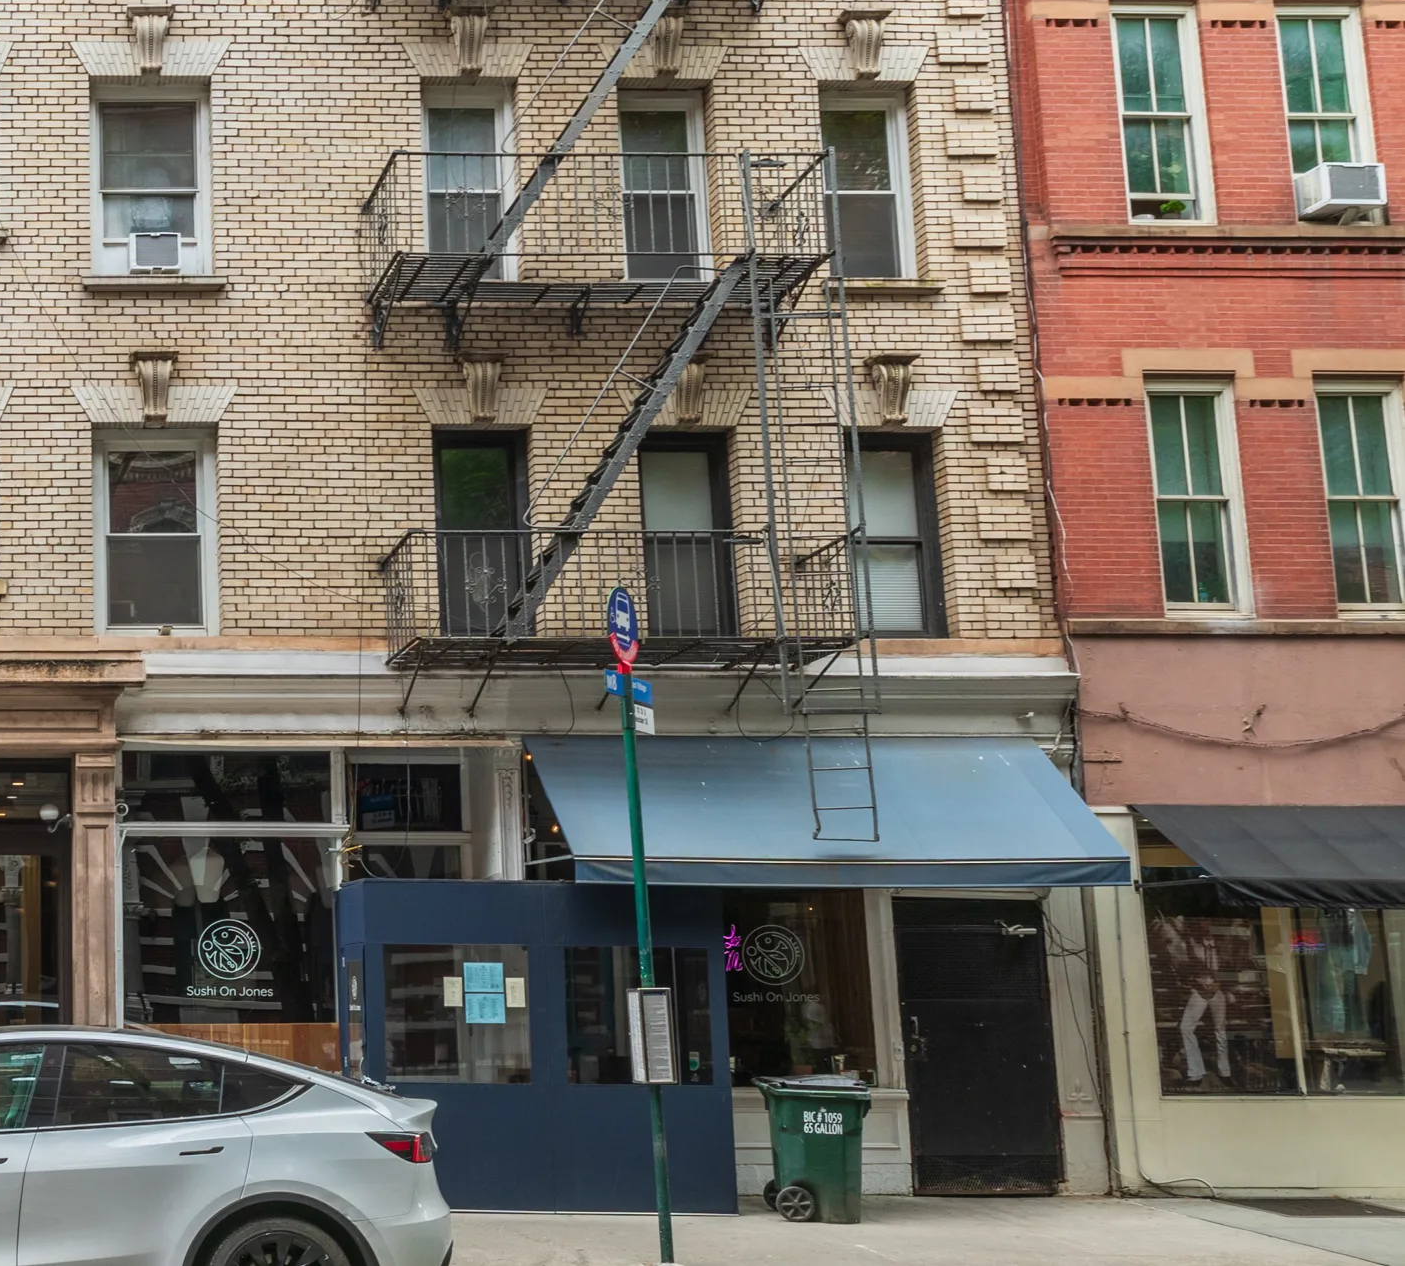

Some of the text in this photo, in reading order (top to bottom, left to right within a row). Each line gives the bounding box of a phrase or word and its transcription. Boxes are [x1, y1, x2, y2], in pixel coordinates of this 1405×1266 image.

[186, 985, 274, 997] Sushi On Jones
[732, 991, 821, 1003] Sushi On Jones
[803, 1110, 816, 1123] BIC
[824, 1112, 843, 1124] 1059
[803, 1122, 843, 1135] 65 GALLON
